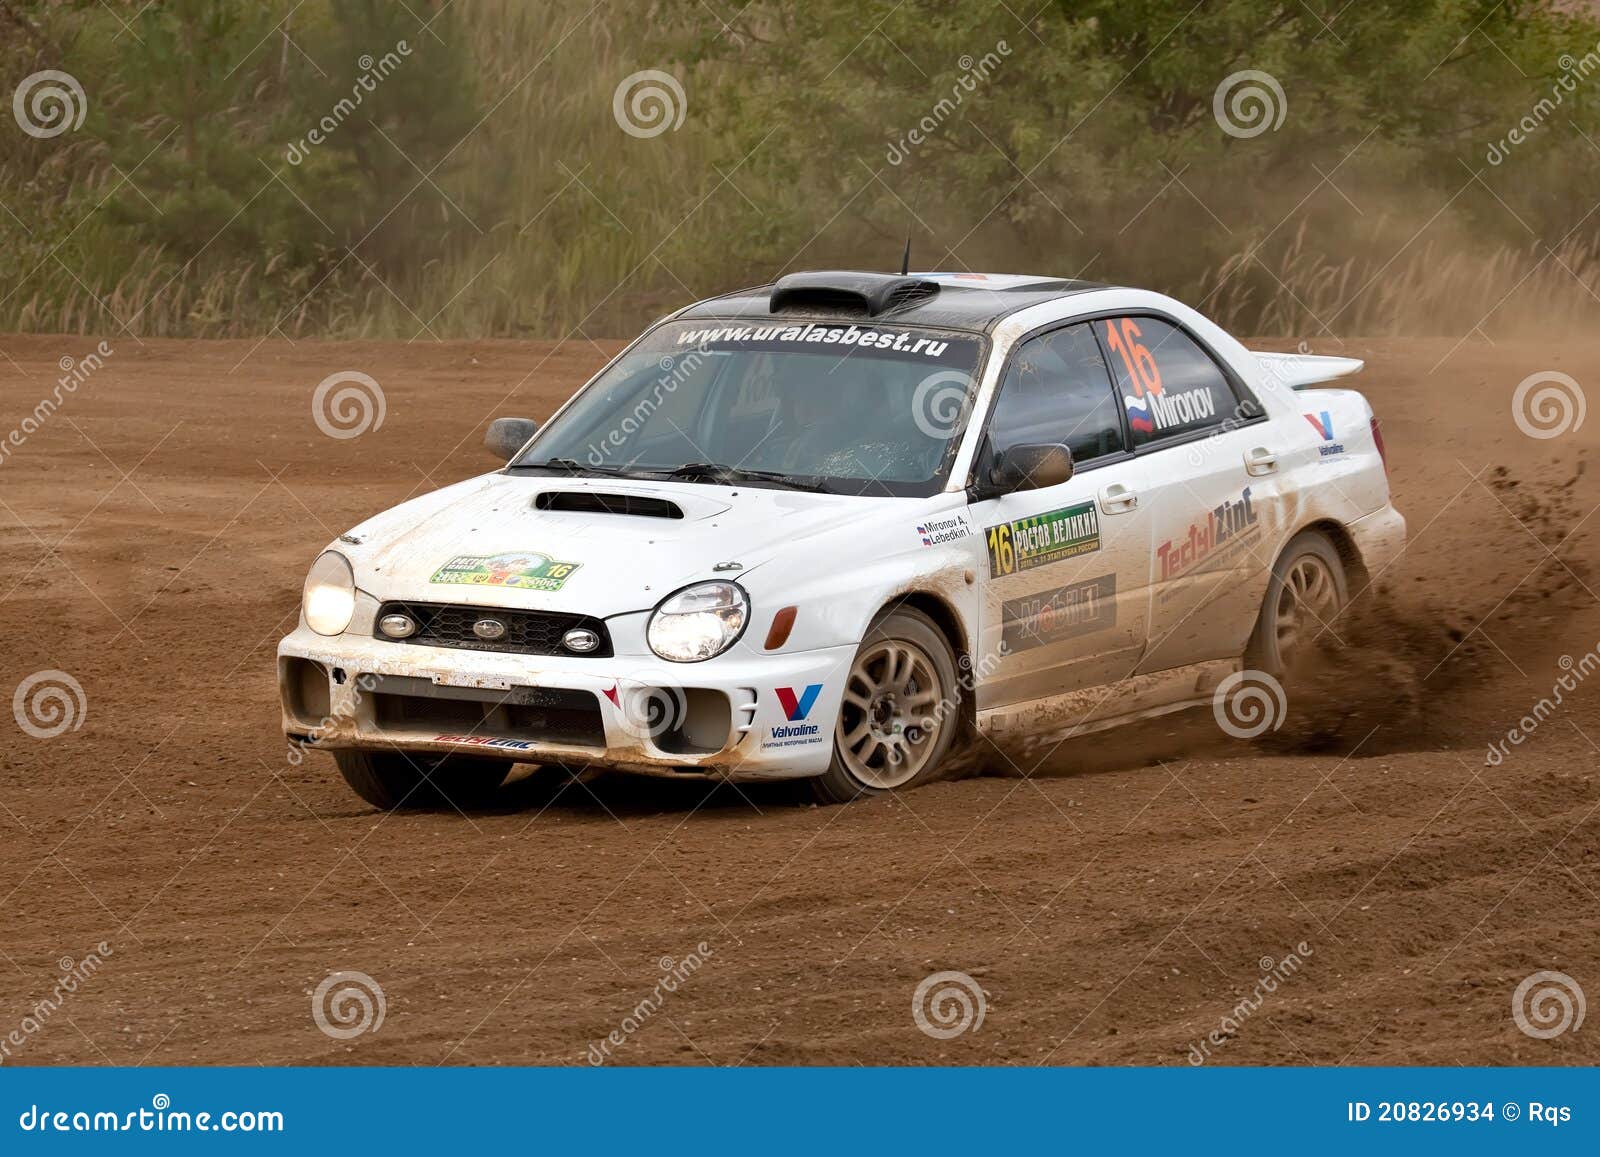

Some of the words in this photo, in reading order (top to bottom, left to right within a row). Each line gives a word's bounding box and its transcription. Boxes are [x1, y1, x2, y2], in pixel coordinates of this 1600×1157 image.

[676, 323, 948, 357] www.uralasbest.ru
[1106, 317, 1163, 398] 16
[1147, 387, 1215, 430] Mironov
[923, 518, 957, 533] Mironov
[957, 515, 968, 526] A.
[929, 527, 967, 545] Lebedkin
[1015, 523, 1051, 554] РОСТОВ
[1052, 507, 1098, 545] ВЕЛИКИЙ
[989, 524, 1014, 576] 16
[545, 563, 573, 579] 16
[771, 724, 820, 739] Valvoline
